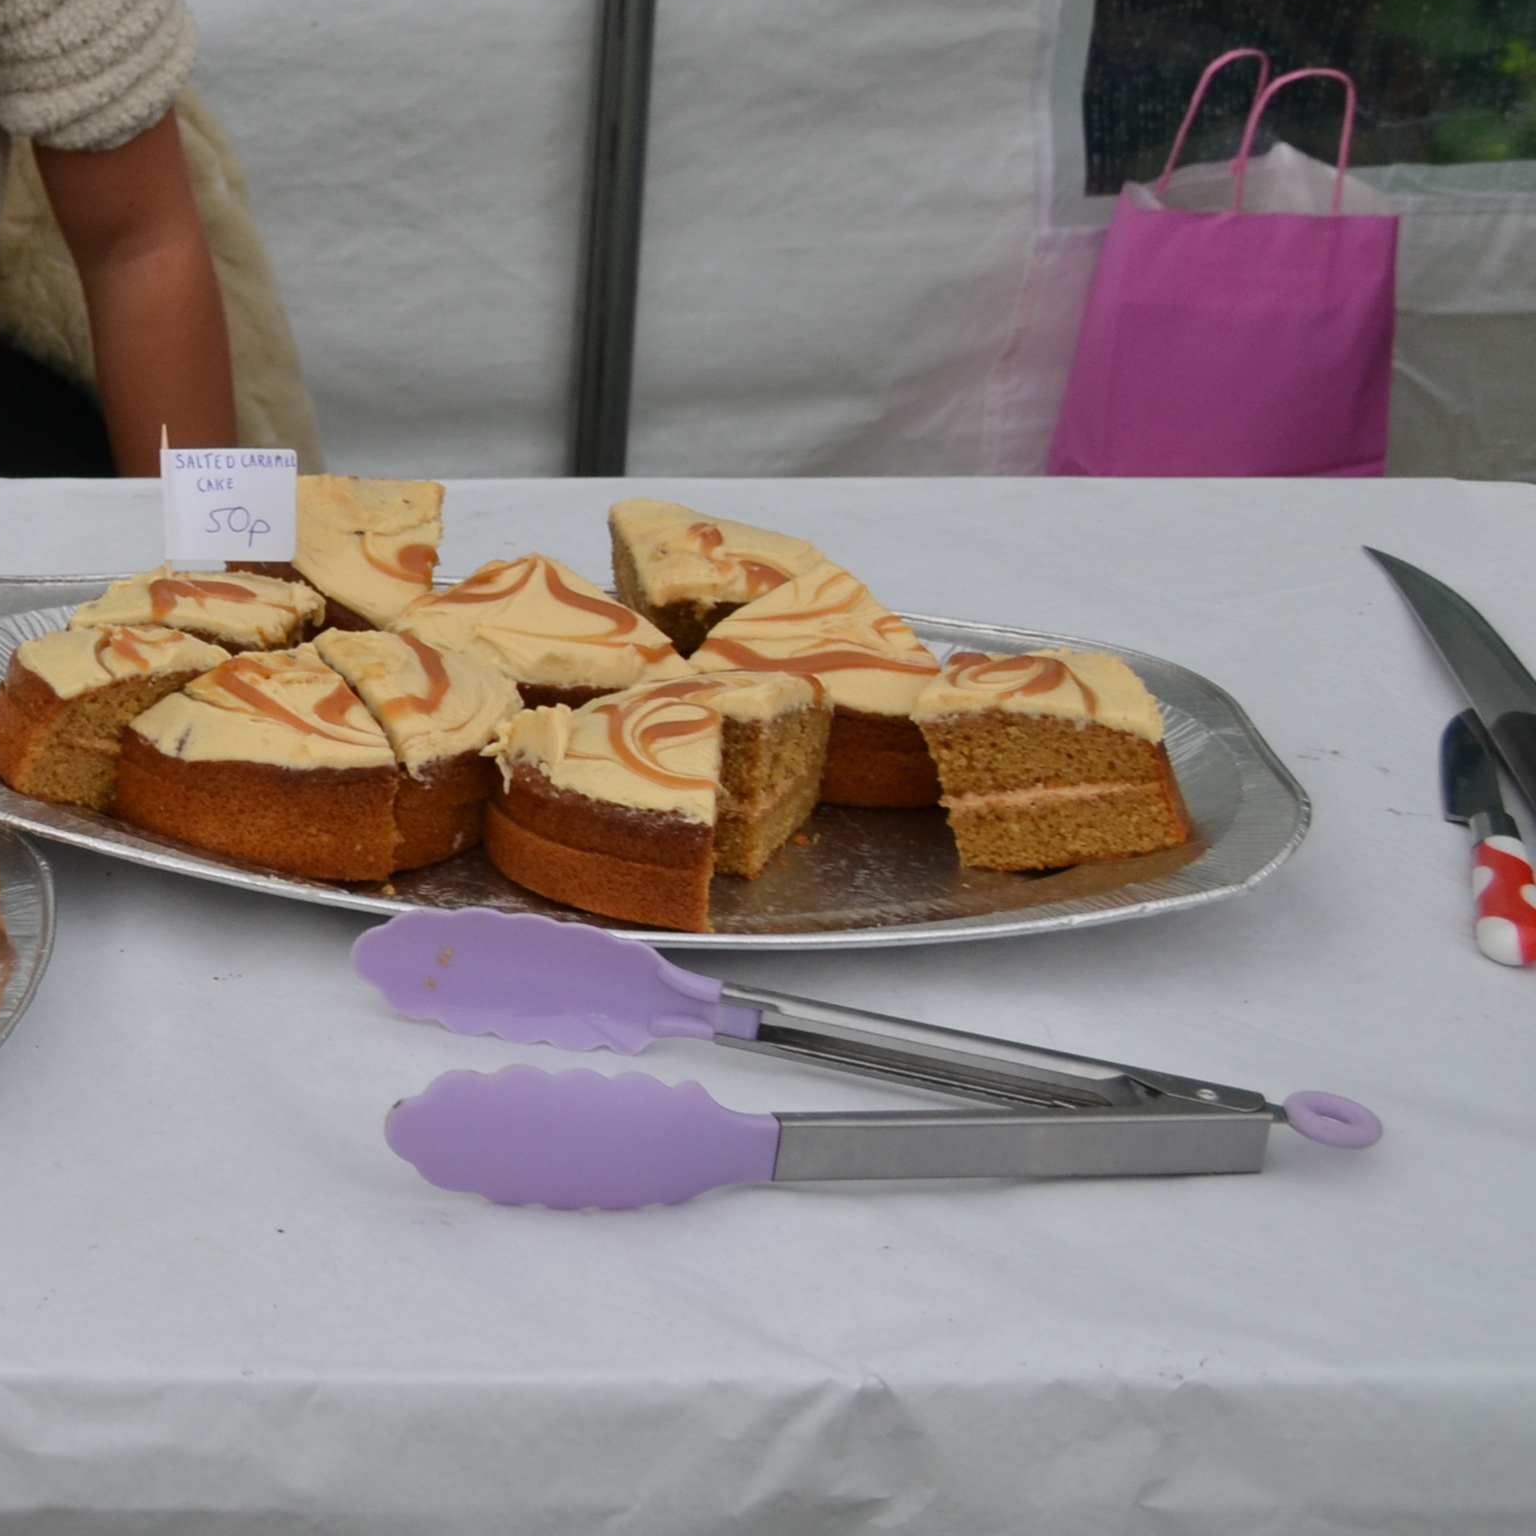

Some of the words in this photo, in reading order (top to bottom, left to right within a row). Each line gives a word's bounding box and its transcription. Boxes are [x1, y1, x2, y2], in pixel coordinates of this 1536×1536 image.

[175, 453, 236, 470] SALTED
[240, 453, 296, 468] CARAMEL
[196, 477, 235, 493] CAKE
[205, 506, 271, 548] 50p
